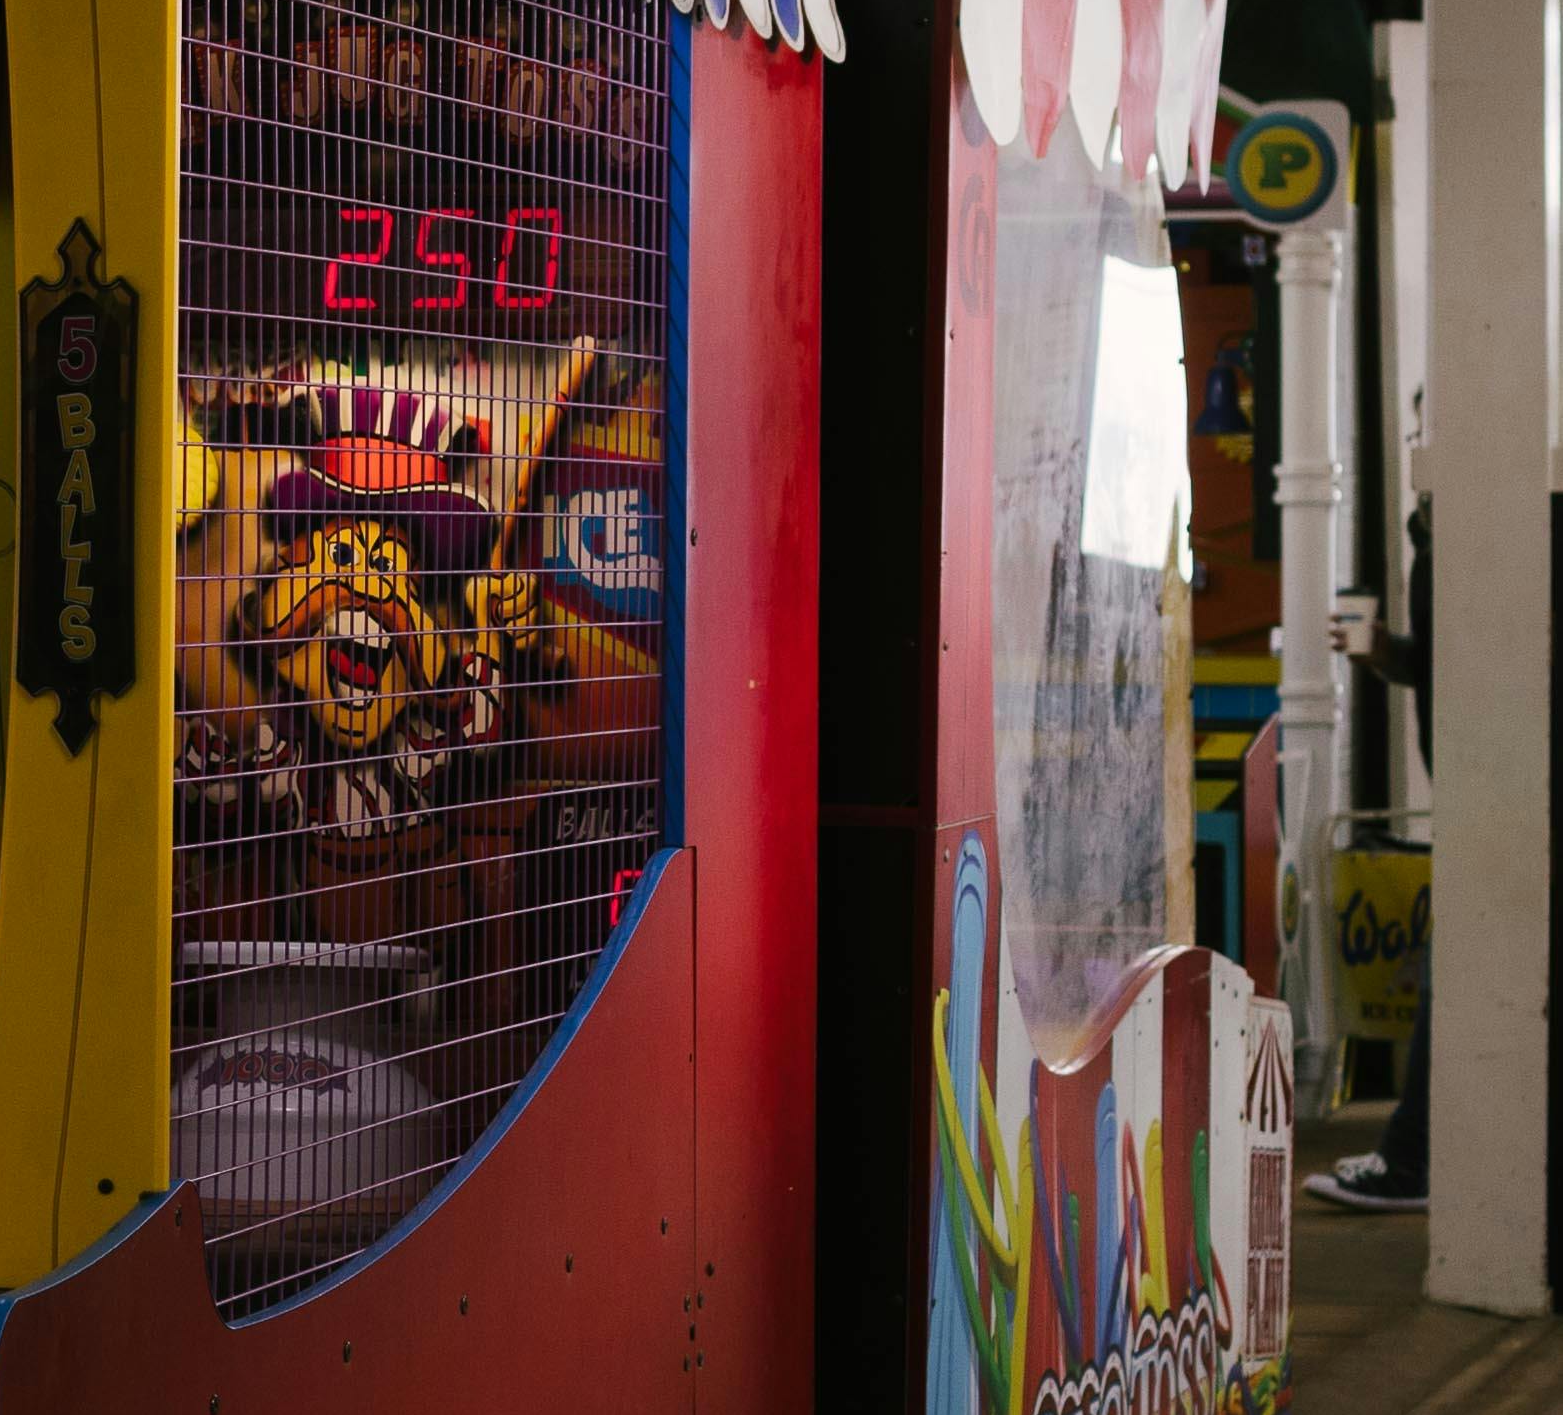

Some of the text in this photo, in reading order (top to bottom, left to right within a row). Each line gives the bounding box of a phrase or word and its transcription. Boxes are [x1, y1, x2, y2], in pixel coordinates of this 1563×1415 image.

[1259, 141, 1311, 190] P
[325, 207, 564, 310] 250
[56, 315, 98, 661] 5 BALLS
[542, 488, 660, 594] ICE
[1341, 887, 1430, 965] Wal
